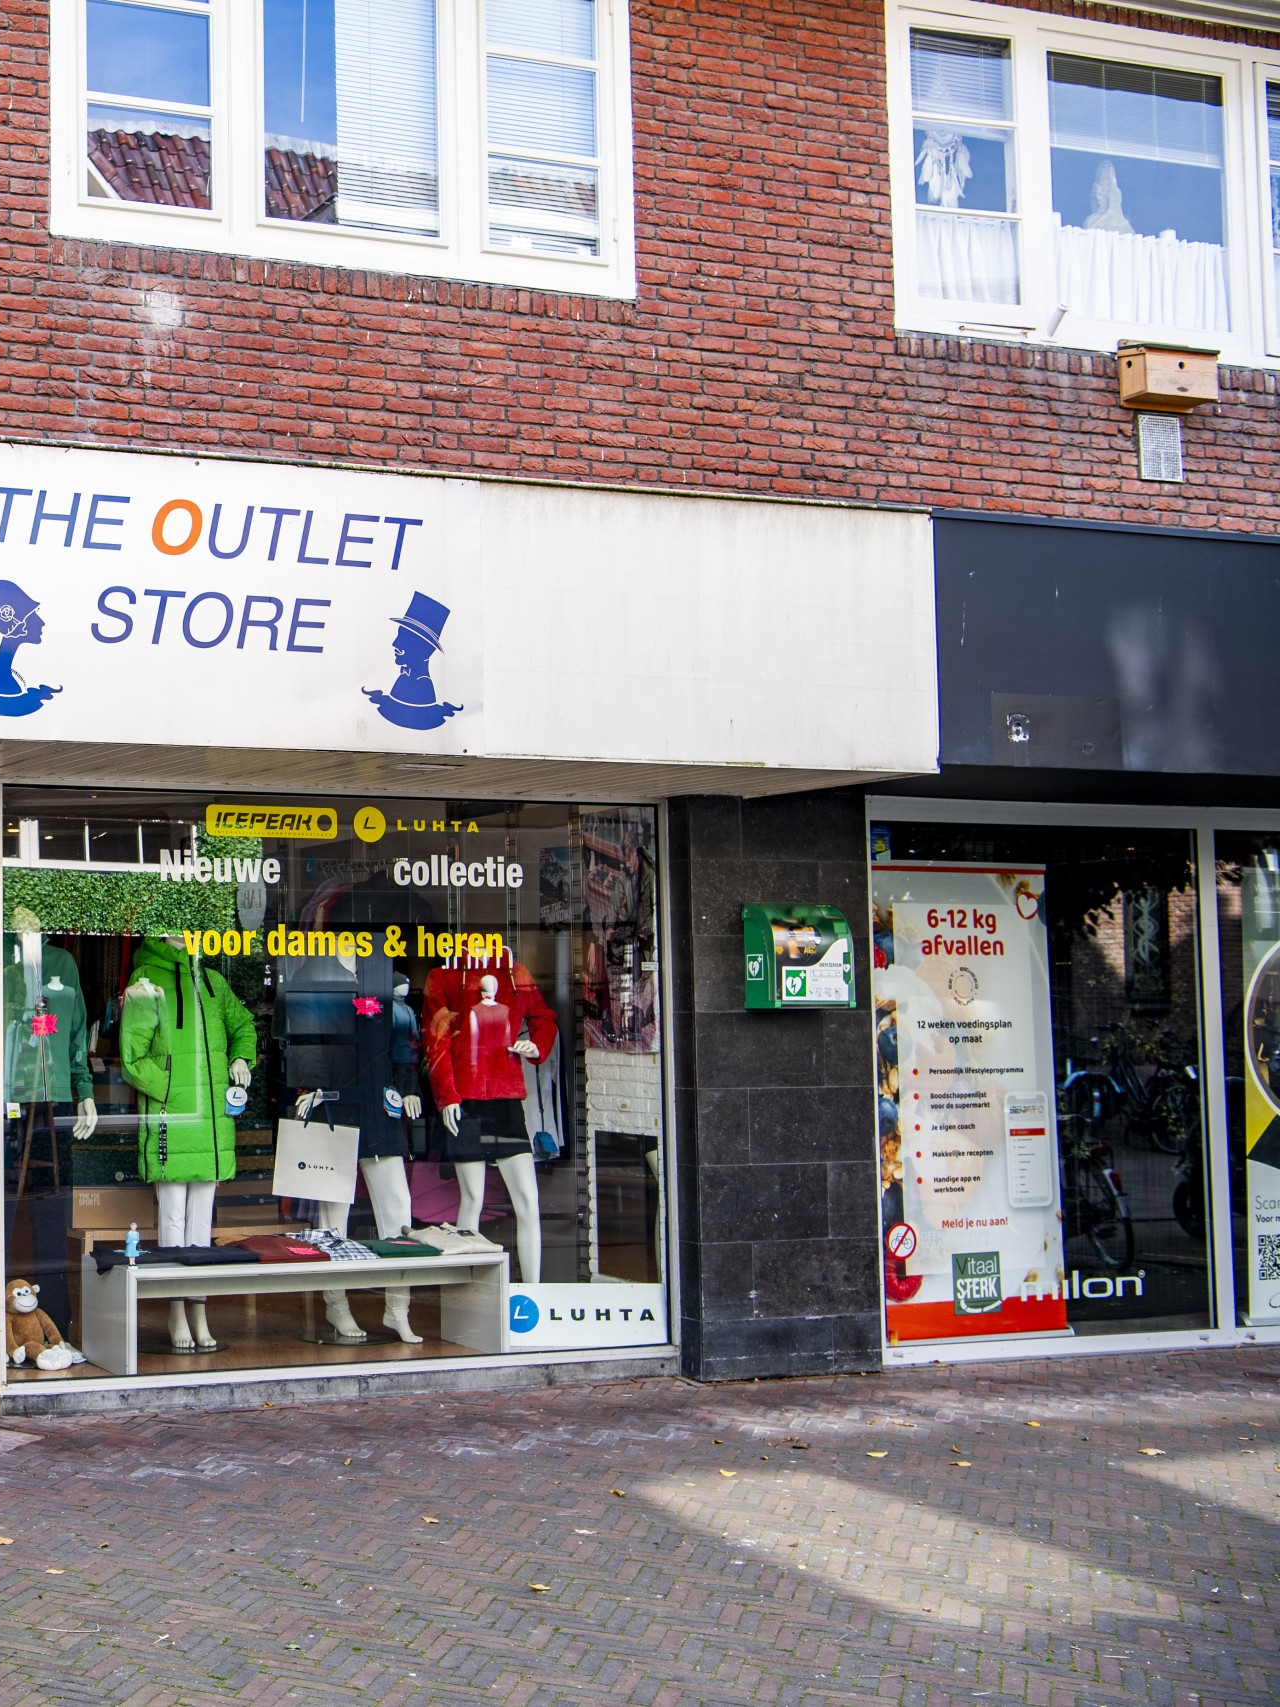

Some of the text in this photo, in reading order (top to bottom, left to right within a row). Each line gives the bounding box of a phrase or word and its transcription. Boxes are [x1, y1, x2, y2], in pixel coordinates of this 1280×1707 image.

[151, 498, 424, 571] OUTLET
[91, 585, 332, 654] STORE
[214, 811, 313, 831] ICEPEAK
[396, 819, 480, 833] LUHTA
[159, 848, 524, 888] Nieuwe collectie
[927, 908, 997, 935] 6-12 kg
[183, 928, 257, 957] voor
[267, 923, 373, 957] dames
[384, 925, 408, 958] &
[417, 925, 504, 958] heren
[921, 934, 1005, 956] afvallen
[917, 1019, 1013, 1031] 12 weken voedingsplan
[949, 1034, 983, 1045] op maat
[929, 1067, 964, 1076] Persoonlijk
[930, 1091, 987, 1099] Boodschappenlijst
[955, 1101, 991, 1110] supermarkt
[939, 1123, 957, 1132] eigen
[957, 1122, 976, 1130] coach
[966, 1149, 994, 1157] recepten
[933, 1175, 960, 1184] Handige
[960, 1176, 972, 1184] app
[934, 1186, 965, 1194] werkboek
[941, 1216, 1009, 1230] Meld je nu aan!
[1255, 1214, 1274, 1223] Voor
[955, 1255, 998, 1275] Vitaal
[956, 1276, 998, 1300] STERK
[549, 1308, 656, 1321] LUHTA
